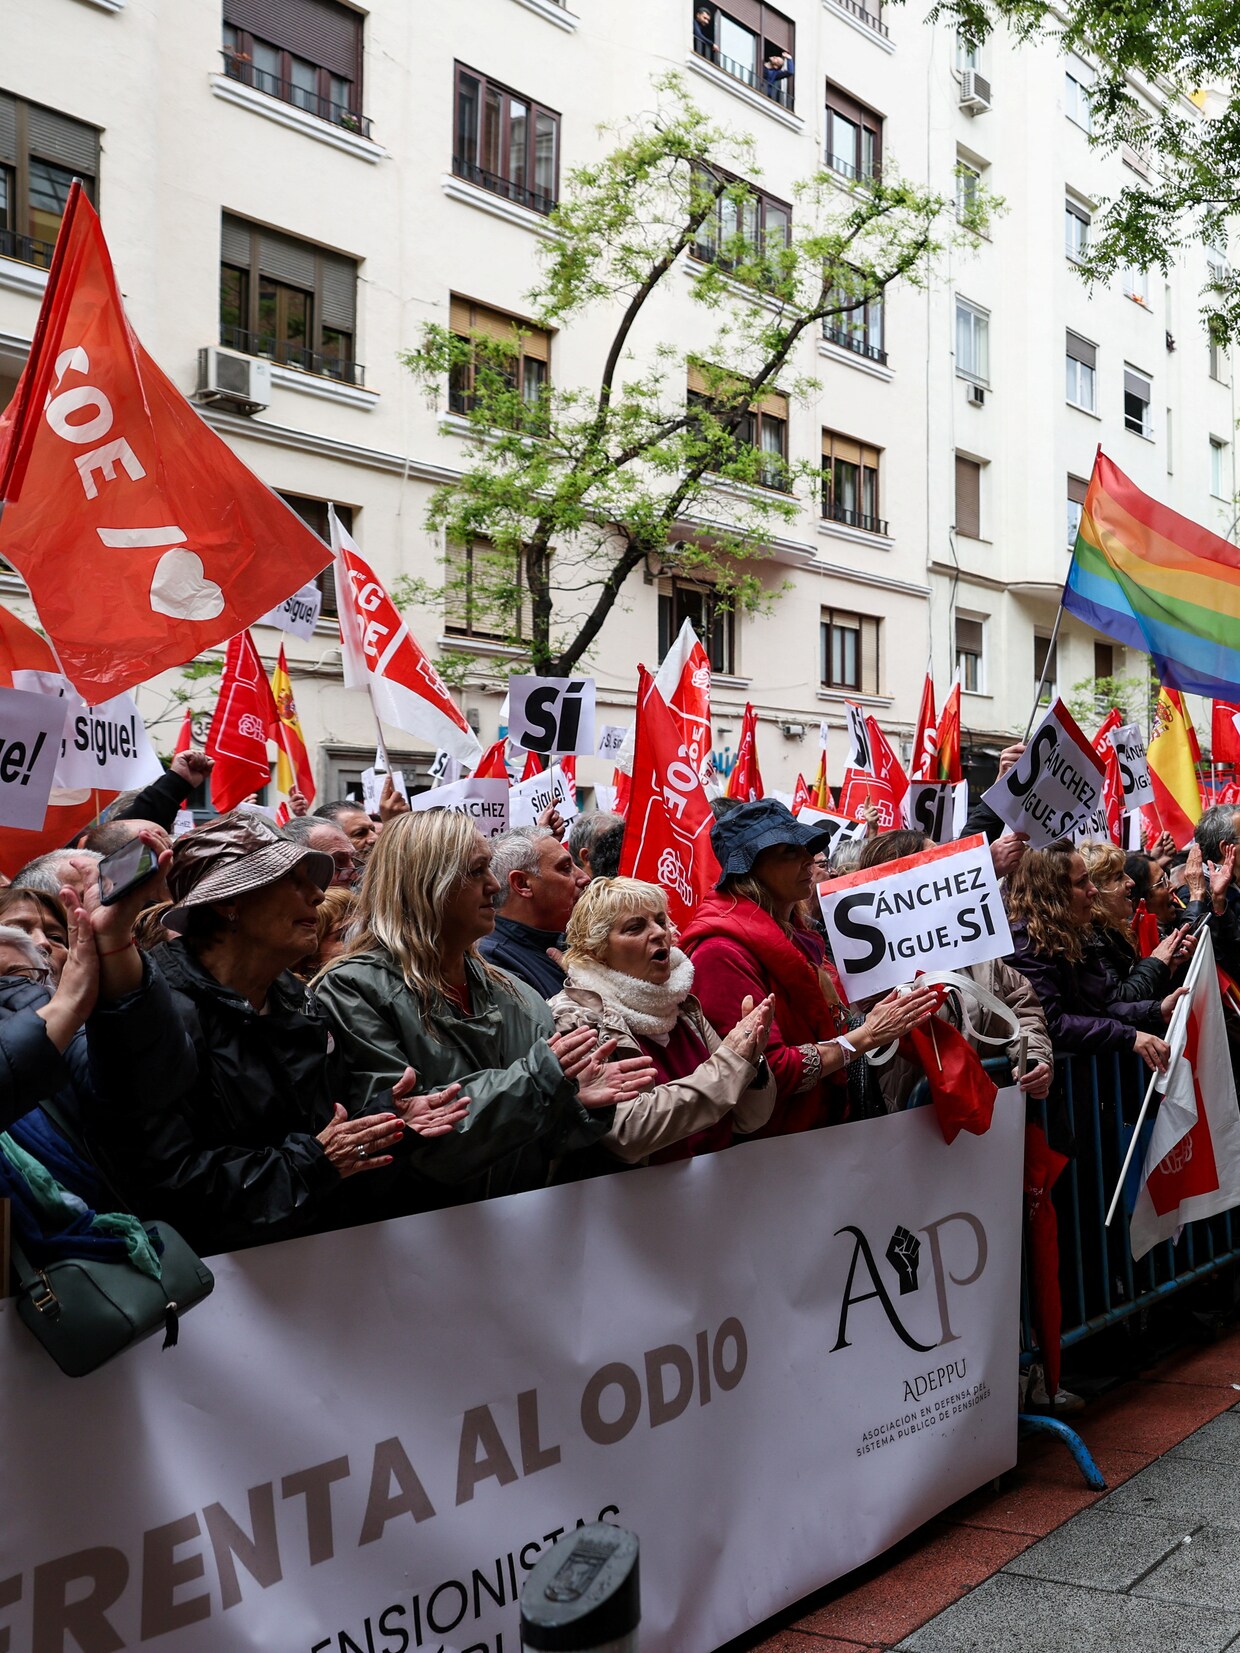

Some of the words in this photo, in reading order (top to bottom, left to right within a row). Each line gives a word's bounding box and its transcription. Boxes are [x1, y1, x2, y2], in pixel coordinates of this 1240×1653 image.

[520, 682, 586, 753] SÍ
[0, 732, 47, 786] e!
[902, 1358, 968, 1402] ADEPPU
[920, 1406, 932, 1417] EN
[934, 1389, 971, 1412] DEFENSA
[973, 1382, 987, 1396] DEL
[454, 1388, 562, 1507] AL
[580, 1316, 749, 1446] ODIO
[856, 1434, 896, 1457] SISTEMA
[898, 1416, 936, 1439] PUBLICO
[939, 1410, 950, 1421] DE
[952, 1389, 991, 1415] PENSIONES
